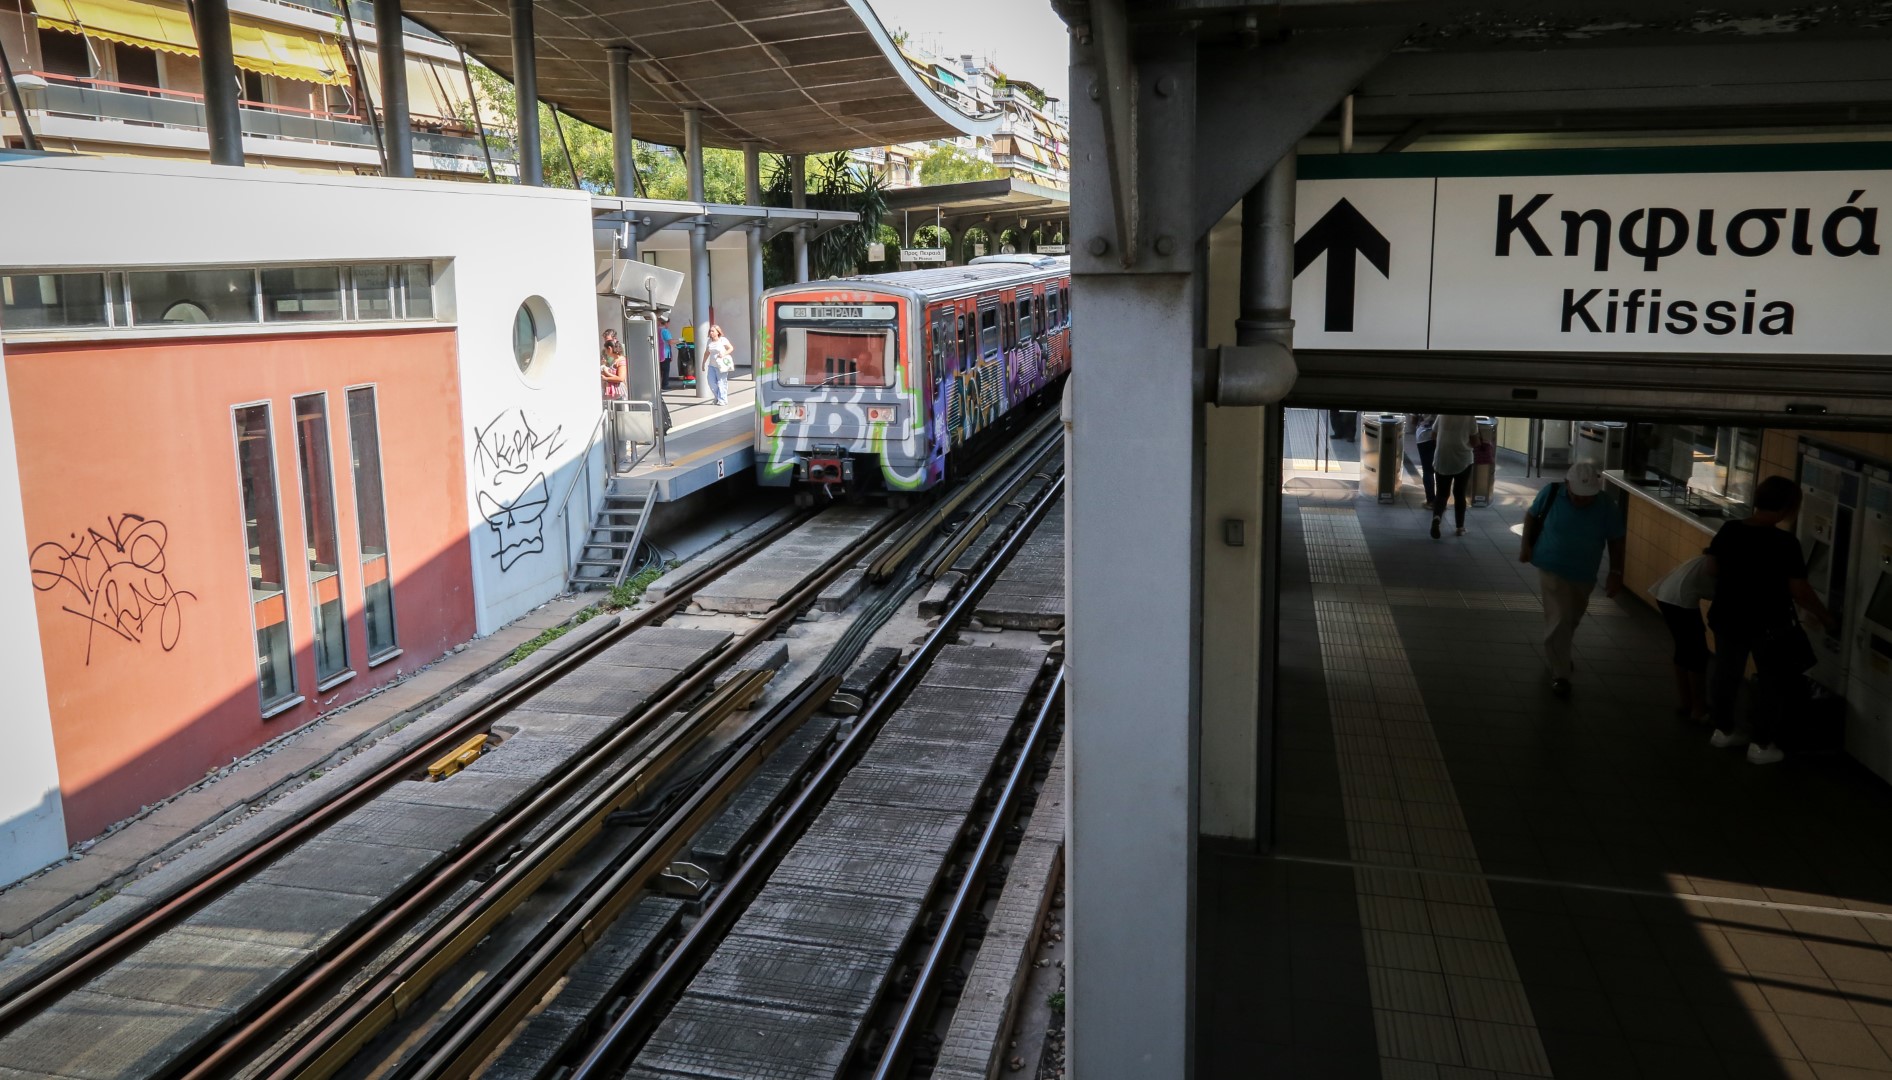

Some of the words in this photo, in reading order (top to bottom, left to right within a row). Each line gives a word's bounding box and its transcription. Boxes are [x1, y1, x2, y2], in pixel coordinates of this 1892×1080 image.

[1496, 190, 1881, 272] Κηφισιά
[815, 308, 860, 317] ΠΕΙΡΑΙΑ
[1560, 289, 1795, 336] Kifissia
